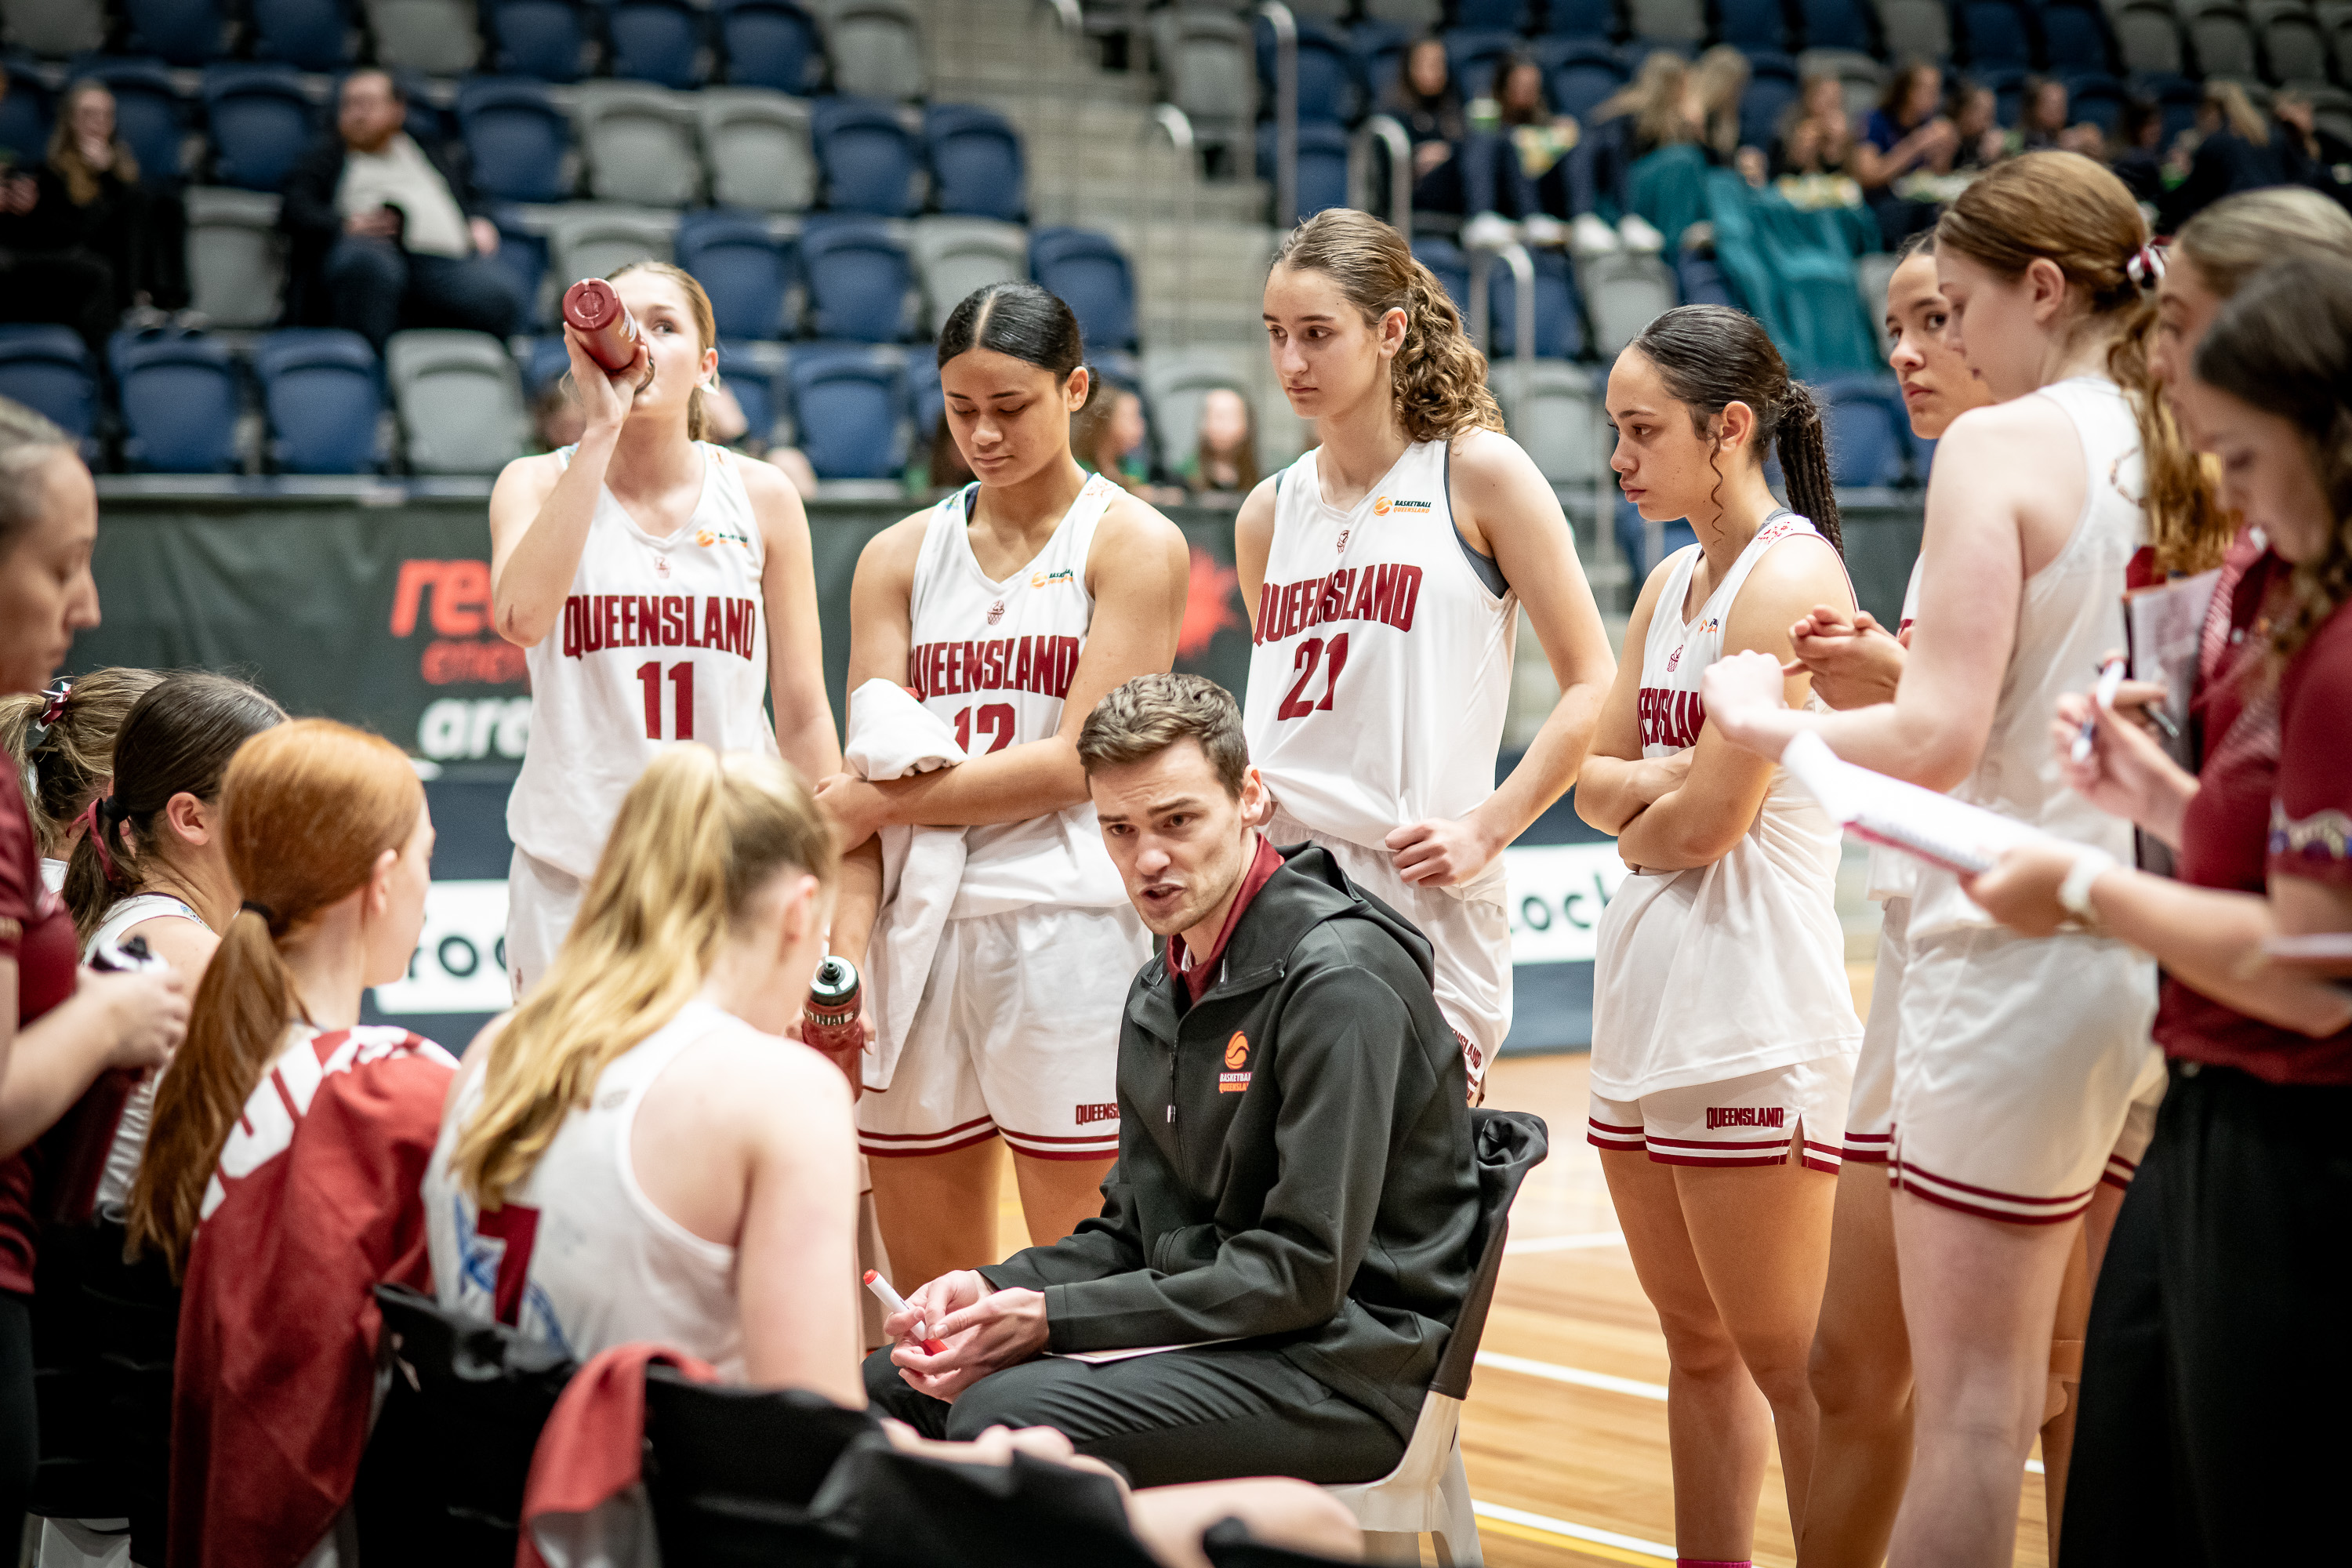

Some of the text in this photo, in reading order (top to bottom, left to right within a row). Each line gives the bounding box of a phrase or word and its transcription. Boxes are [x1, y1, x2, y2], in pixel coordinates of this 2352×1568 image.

[390, 558, 495, 638] re
[563, 595, 757, 662] QUEENSLAND
[637, 662, 695, 740] 11
[910, 635, 1080, 702] UEENSLAND
[1277, 632, 1348, 721] 21
[954, 702, 1016, 755] 12
[1706, 1106, 1784, 1131] QUEENSLAND
